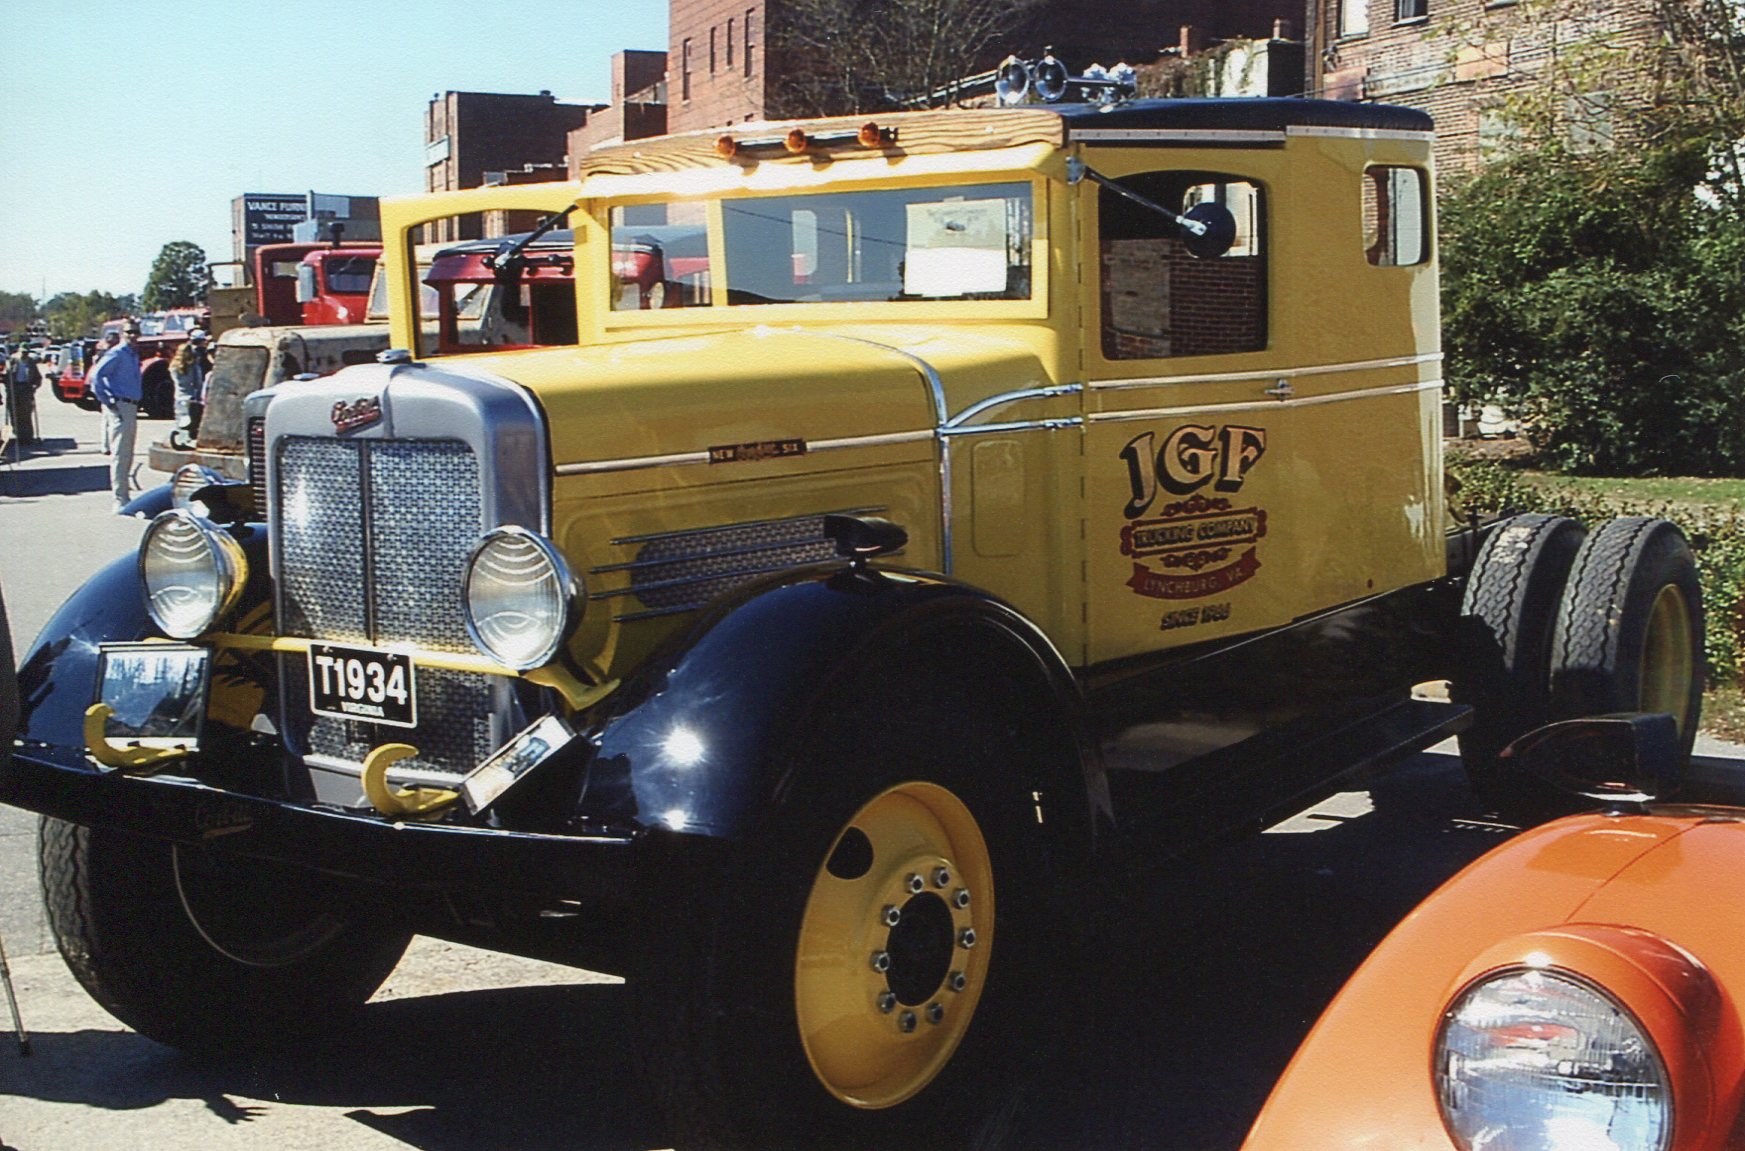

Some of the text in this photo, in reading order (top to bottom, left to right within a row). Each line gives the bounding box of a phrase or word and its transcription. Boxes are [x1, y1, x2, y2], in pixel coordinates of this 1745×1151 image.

[247, 202, 278, 211] VANCE
[1119, 424, 1266, 519] JGF
[1134, 517, 1257, 549] TRUCKING COMPANY
[1160, 607, 1200, 631] SINCE
[316, 655, 408, 705] T1934
[341, 701, 385, 717] VIRGINIA
